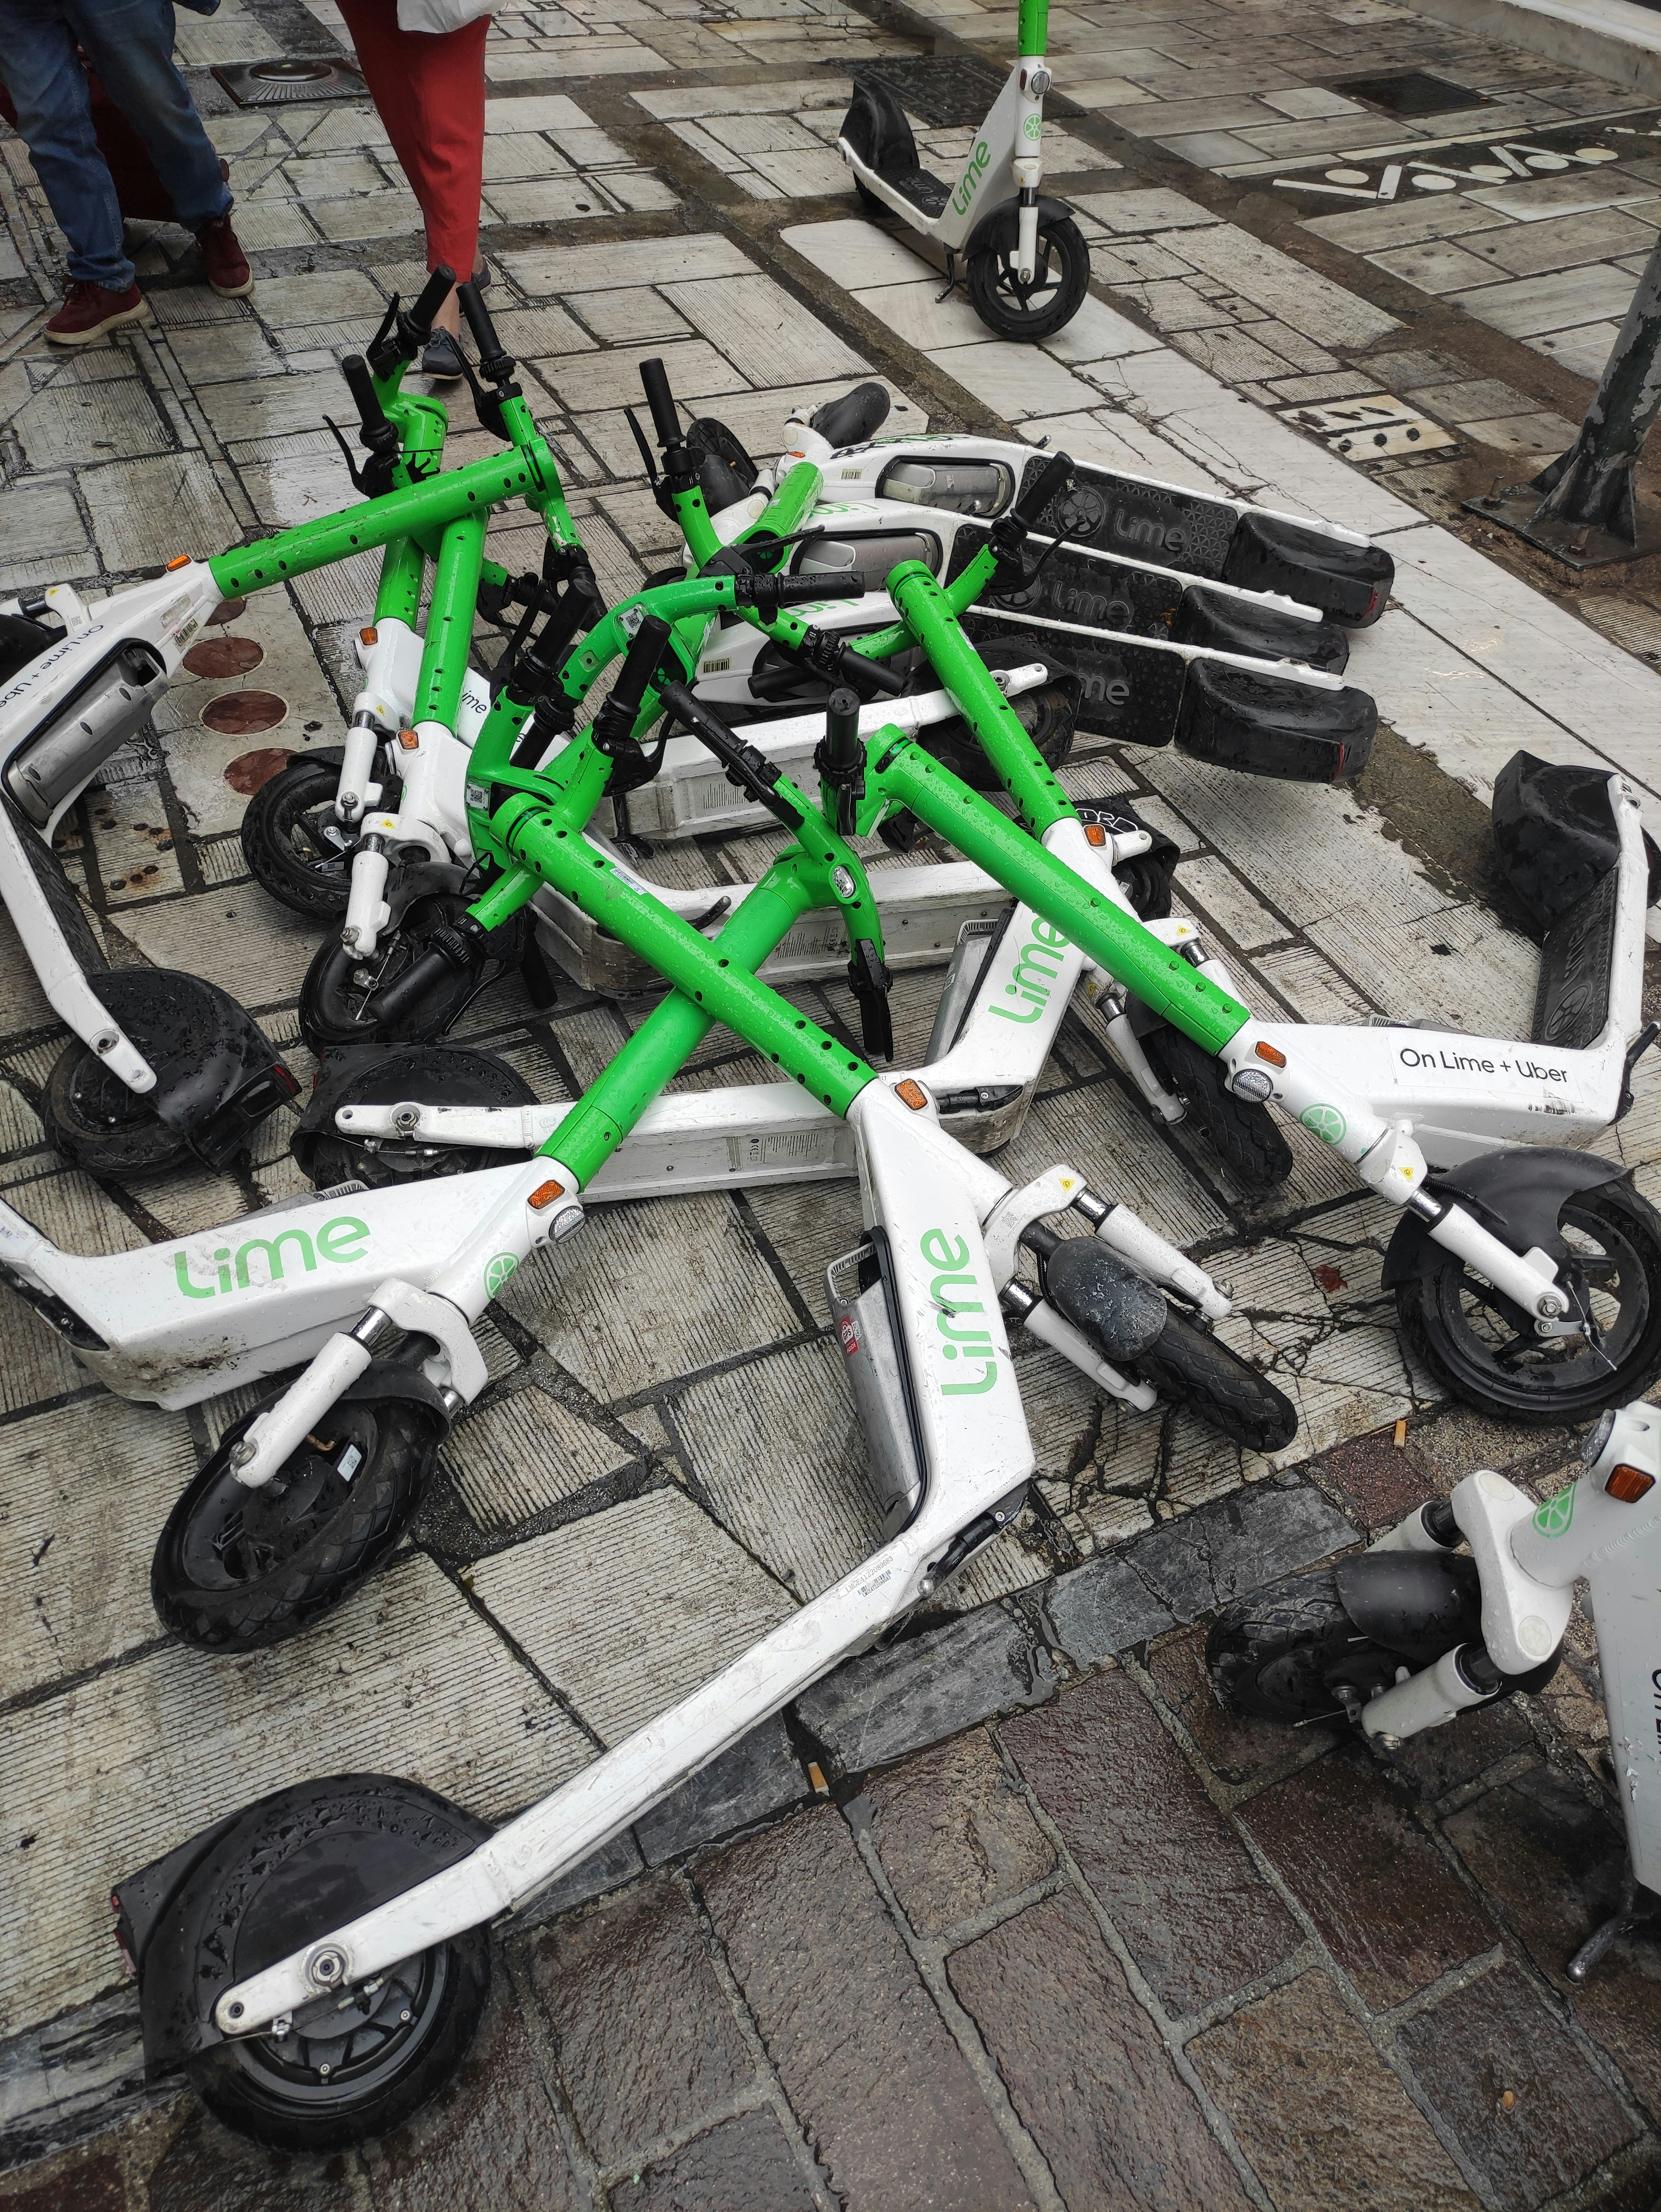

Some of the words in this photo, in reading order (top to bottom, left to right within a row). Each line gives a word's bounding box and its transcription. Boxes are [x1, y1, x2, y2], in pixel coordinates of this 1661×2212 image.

[952, 141, 991, 215] Lime
[808, 502, 879, 518] Lim
[1115, 509, 1186, 551] Lime
[790, 599, 860, 617] Lim
[1053, 581, 1130, 624] Lime
[77, 625, 104, 639] On
[40, 641, 81, 670] Lime
[0, 682, 32, 708] Ube
[462, 690, 487, 713] ime
[1077, 673, 1129, 705] me
[987, 917, 1071, 1024] Lime
[1400, 1048, 1436, 1067] On
[1440, 1051, 1495, 1073] Lime
[1500, 1061, 1511, 1072] +
[1515, 1060, 1567, 1083] Uber
[174, 1216, 371, 1299] Lime
[920, 1228, 998, 1395] Lime
[843, 1328, 852, 1340] GPS
